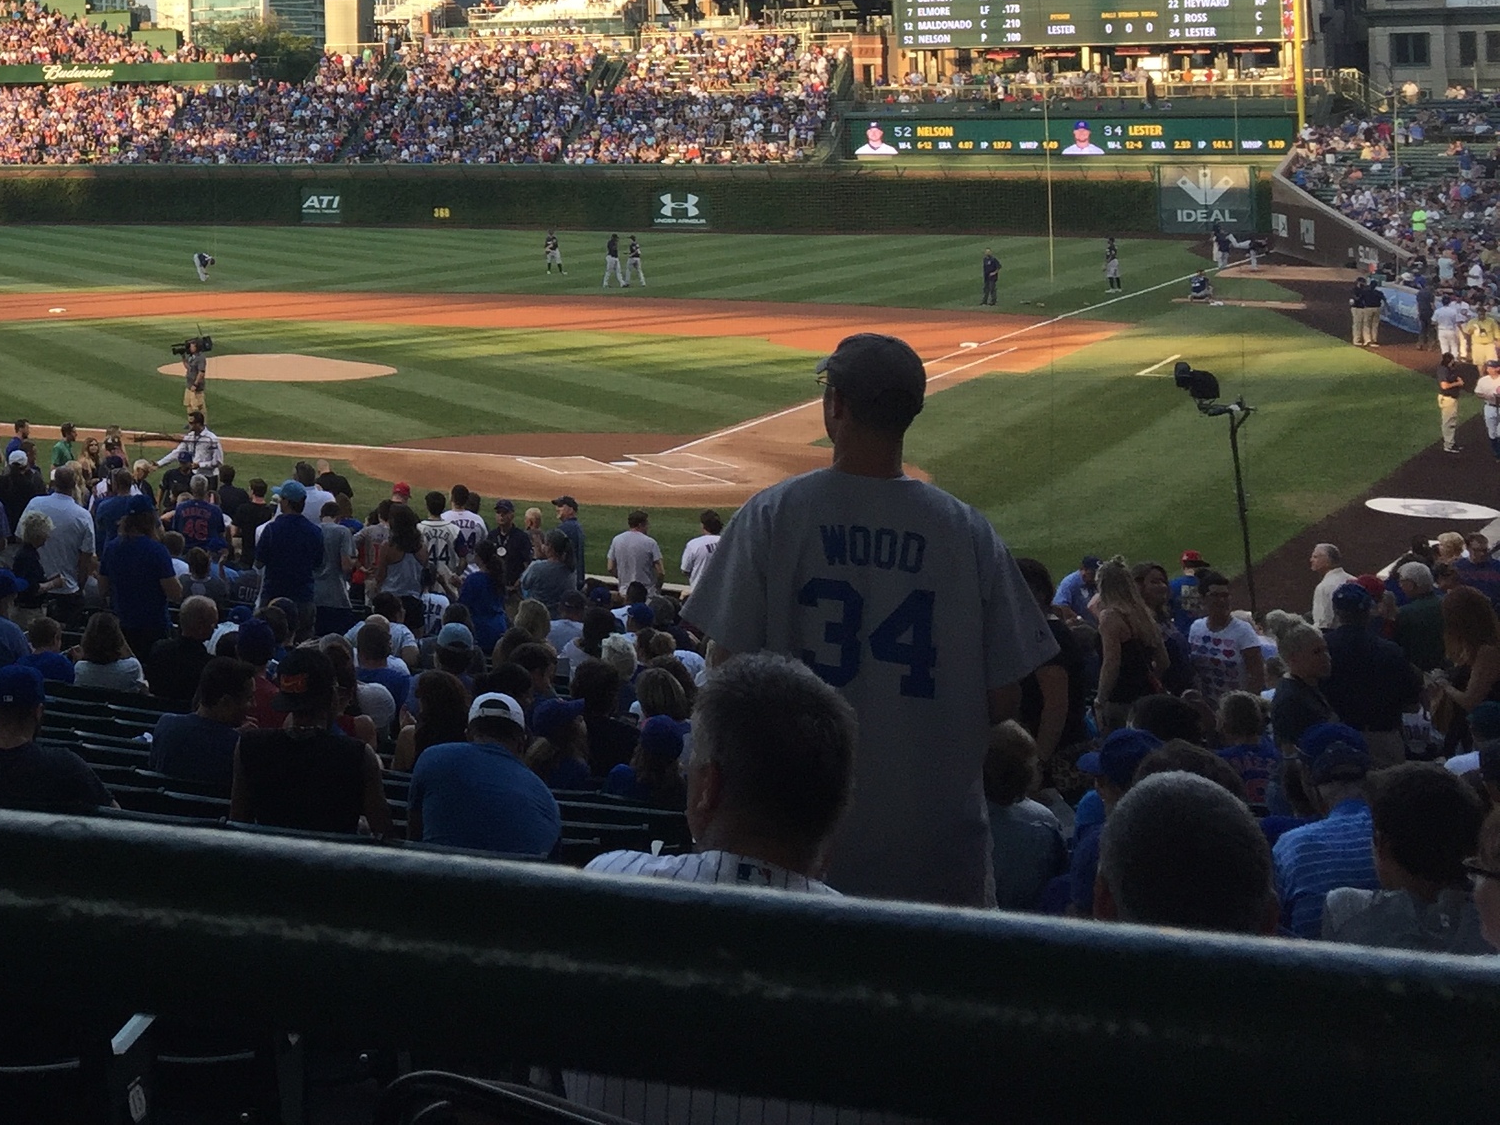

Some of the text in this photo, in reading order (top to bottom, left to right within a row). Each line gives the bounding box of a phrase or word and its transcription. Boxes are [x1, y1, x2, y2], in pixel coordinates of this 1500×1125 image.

[1168, 0, 1180, 9] 22
[907, 8, 913, 17] 7
[918, 7, 950, 17] ELMORE
[980, 5, 990, 15] LF
[1174, 11, 1262, 23] 3 ROSS C
[904, 22, 914, 31] 12
[918, 20, 973, 29] MALDONADO
[980, 19, 988, 29] C
[1047, 25, 1076, 35] LESTER
[1105, 22, 1154, 33] 0 0 0
[1169, 26, 1264, 37] 34 LESTER P
[904, 35, 914, 44] 52
[918, 35, 951, 43] NELSON
[981, 33, 988, 43] P
[42, 64, 114, 80] Budweiser
[894, 126, 954, 137] 52 NELSON
[1104, 125, 1164, 136] 34 LESTER
[980, 141, 989, 149] IP
[302, 195, 340, 208] ATI
[1176, 209, 1237, 223] IDEAL
[424, 527, 450, 541] RIZZO
[427, 543, 450, 566] 44
[819, 524, 926, 574] WOOD
[797, 577, 937, 700] 34
